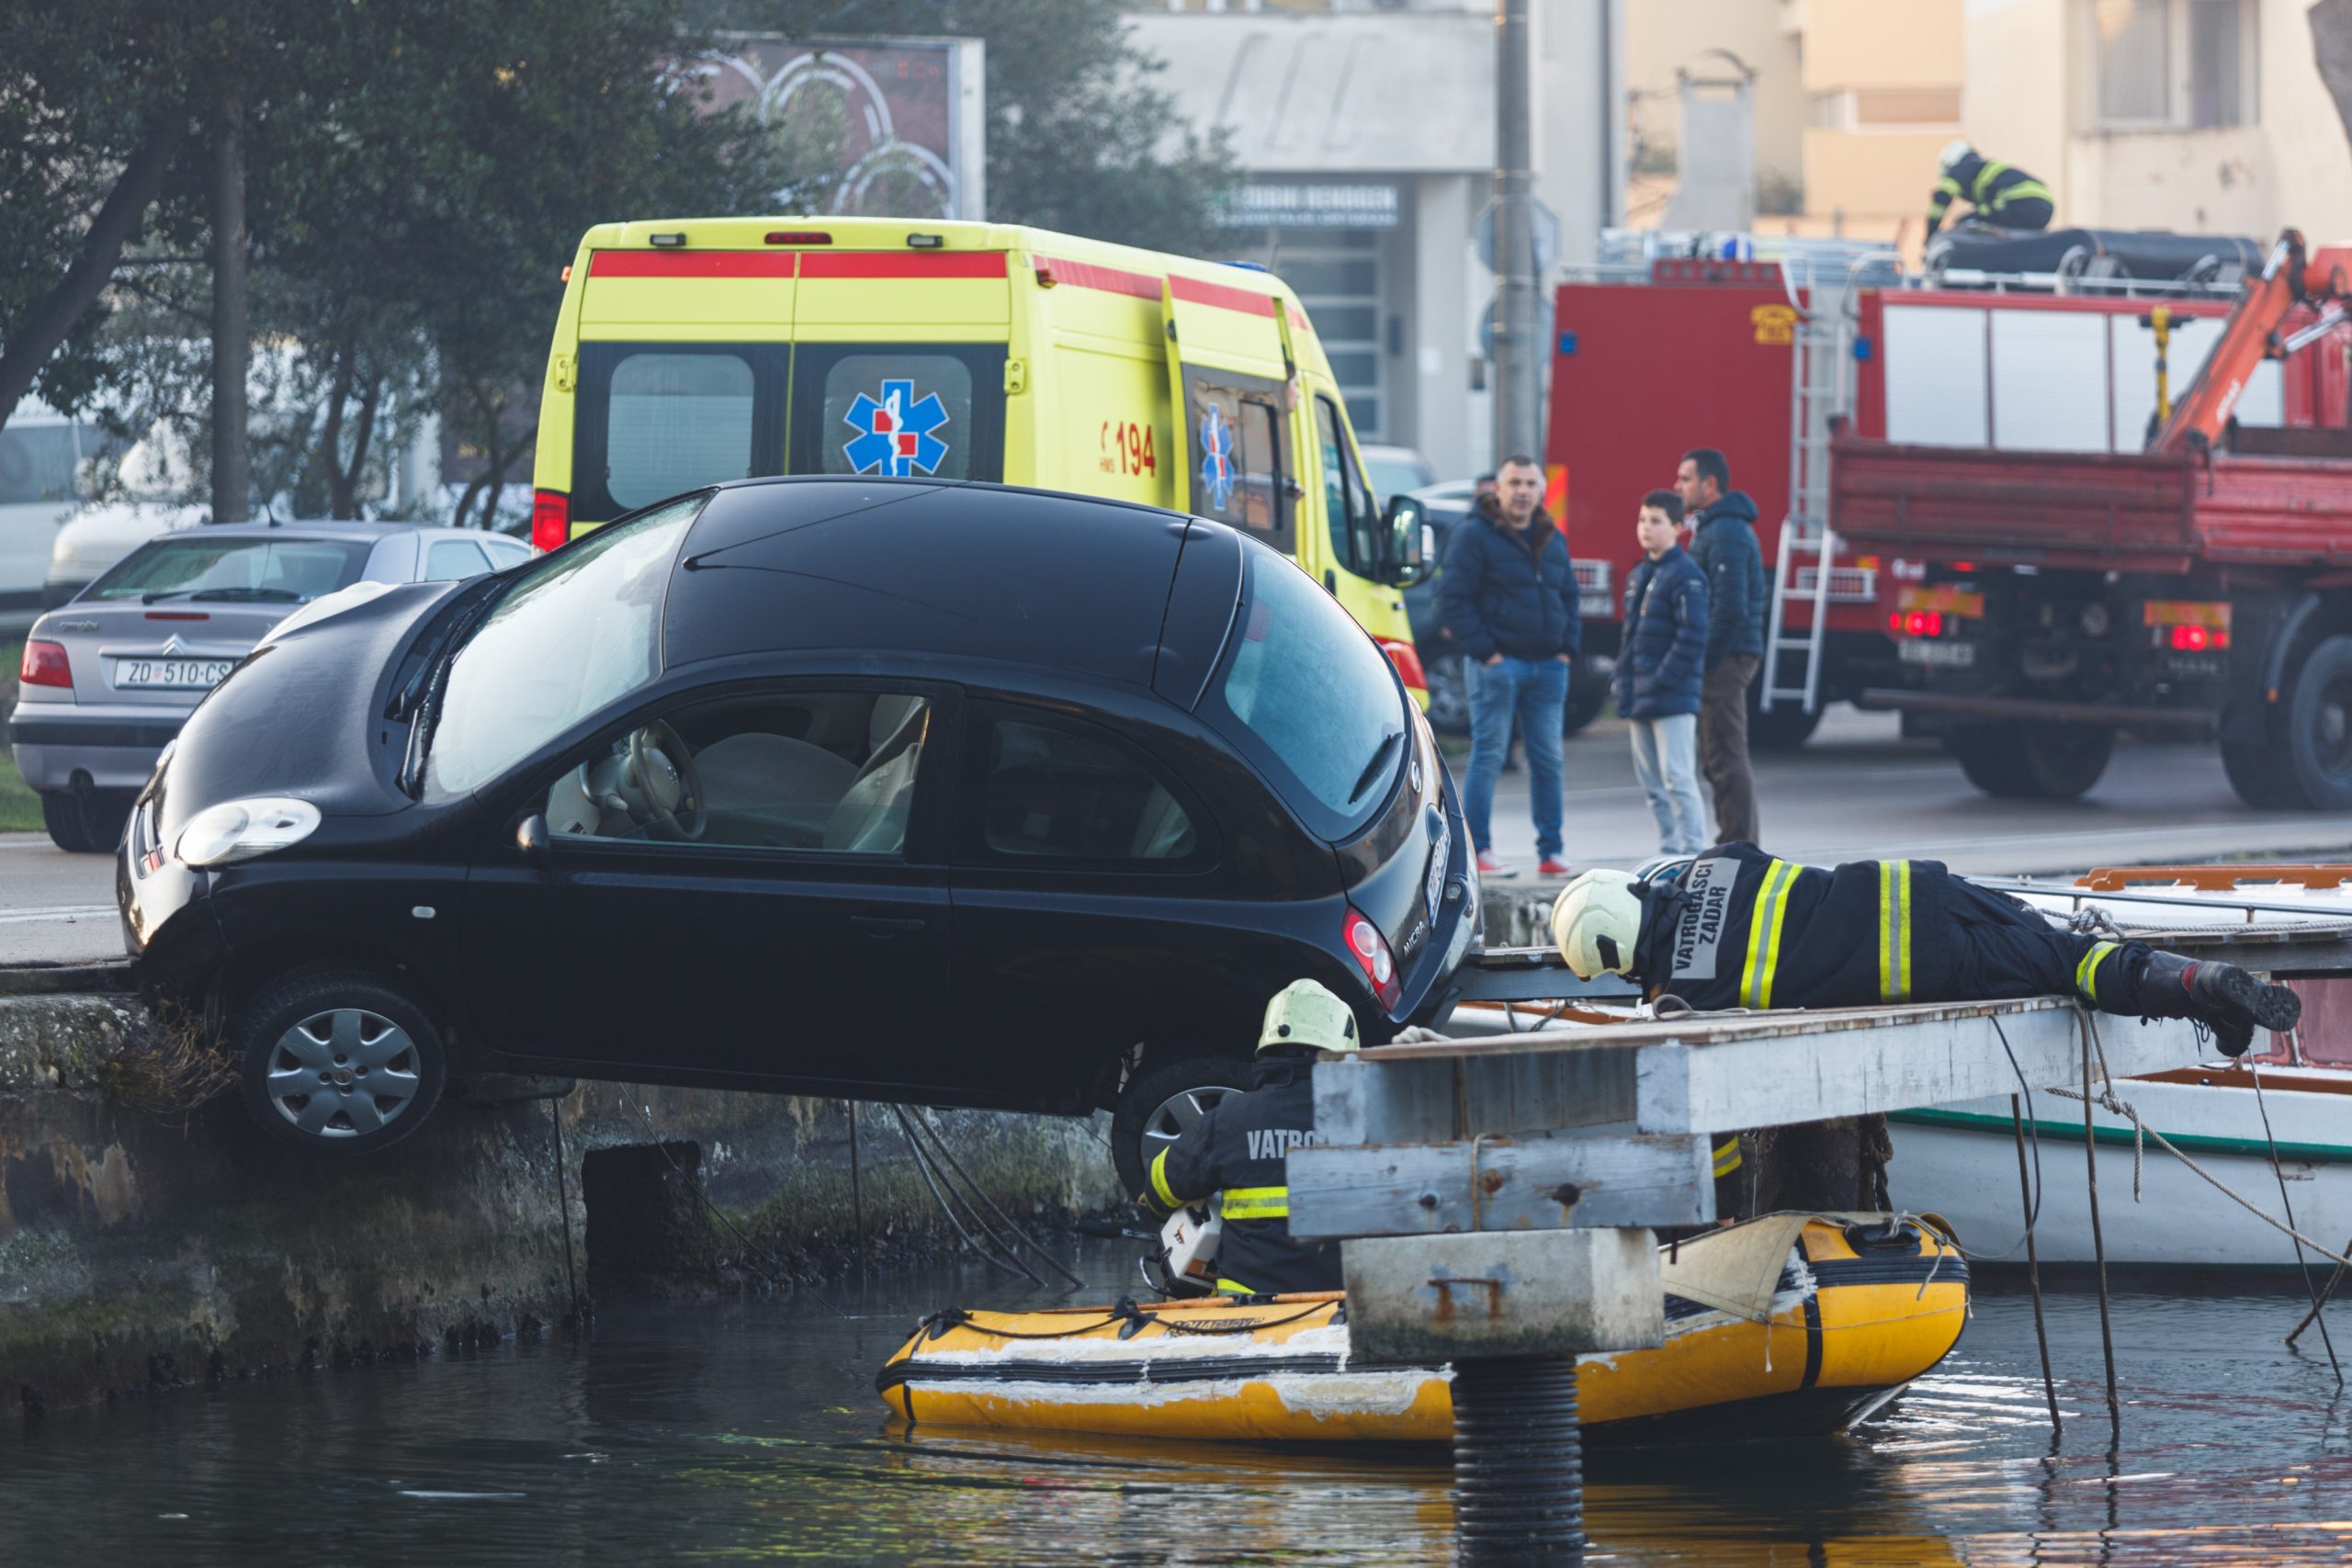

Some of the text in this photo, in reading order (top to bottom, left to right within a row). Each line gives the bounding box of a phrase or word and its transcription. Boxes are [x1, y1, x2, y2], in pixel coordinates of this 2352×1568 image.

[1115, 421, 1156, 478] 194
[129, 661, 152, 683] ZD
[1402, 920, 1426, 956] MICRA
[1674, 863, 1714, 971] VATROGASCI
[1698, 886, 1727, 944] ZADAR
